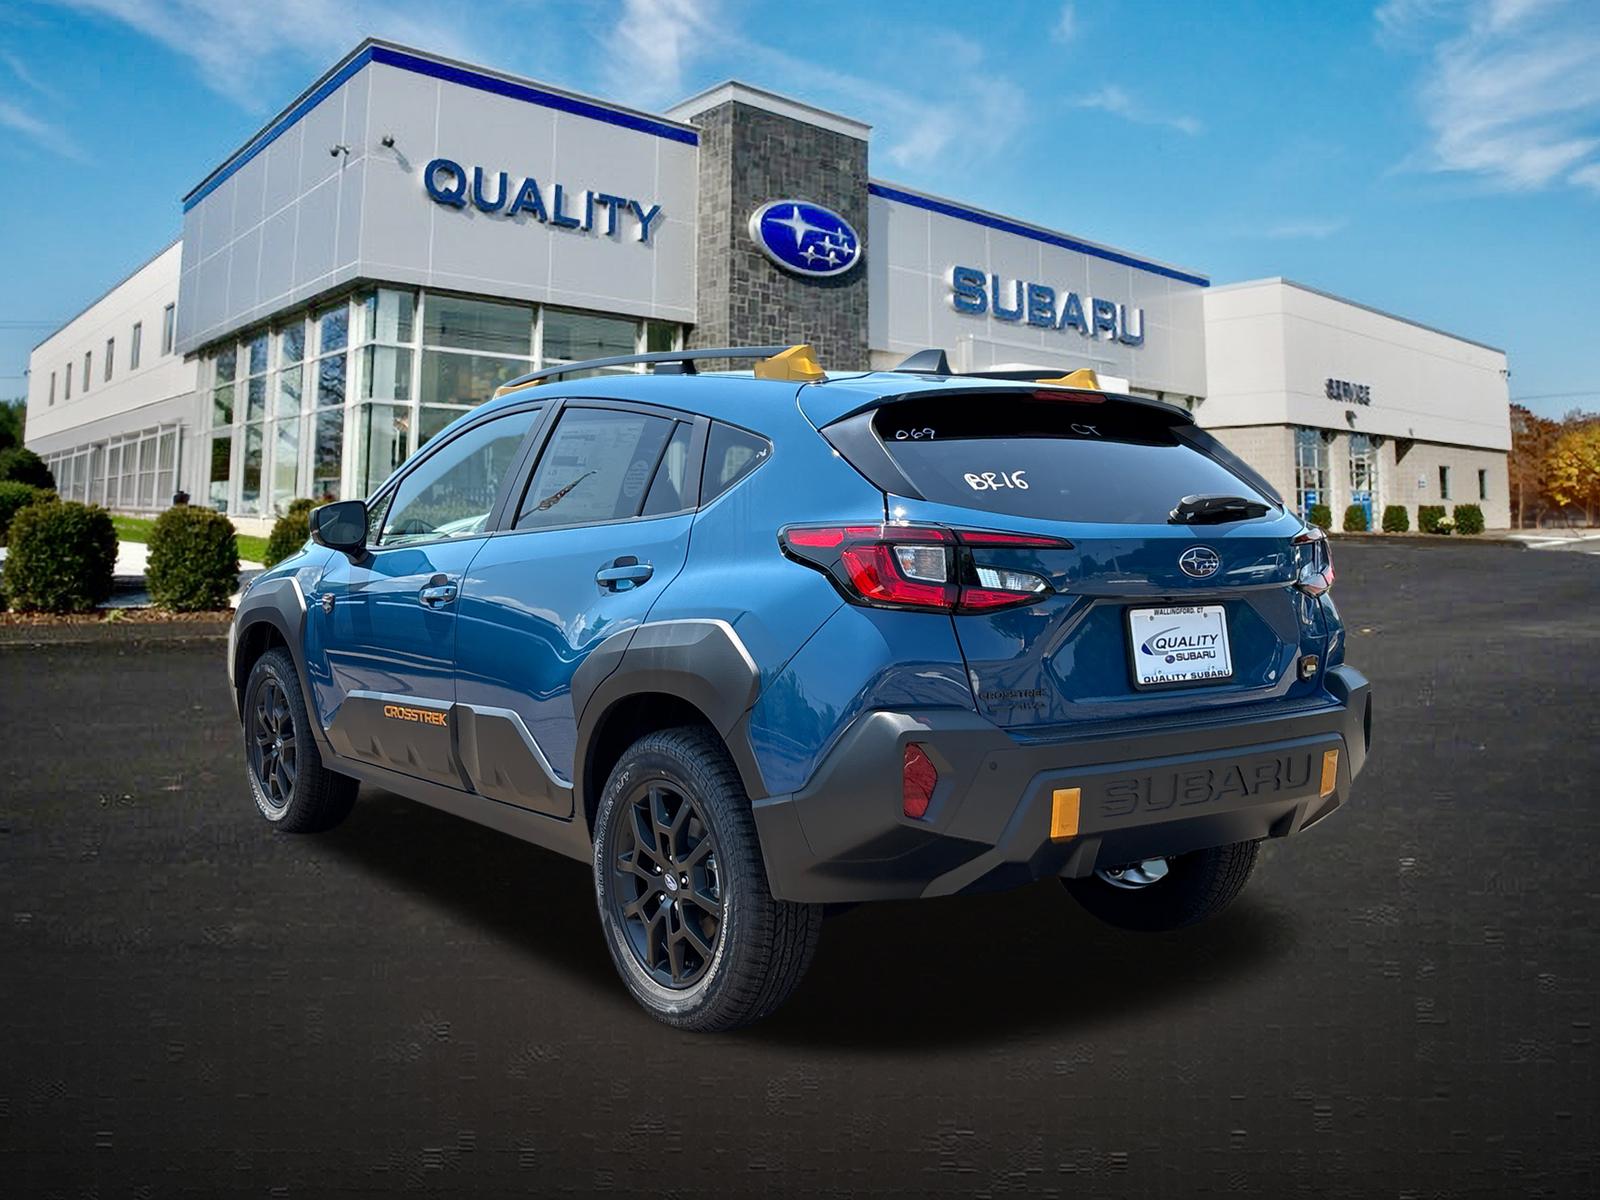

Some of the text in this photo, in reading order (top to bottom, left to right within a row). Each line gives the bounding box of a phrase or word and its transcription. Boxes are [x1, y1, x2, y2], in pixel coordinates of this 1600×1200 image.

[424, 158, 661, 243] QUALITY
[949, 265, 1145, 346] SUBARU
[963, 470, 1030, 491] BR16
[1156, 634, 1218, 649] QUALITY
[1176, 650, 1216, 662] SUBARU
[1144, 669, 1230, 683] QUALITY SUBARU
[384, 705, 448, 727] CROSSTREK
[1100, 752, 1312, 818] SUBARU
